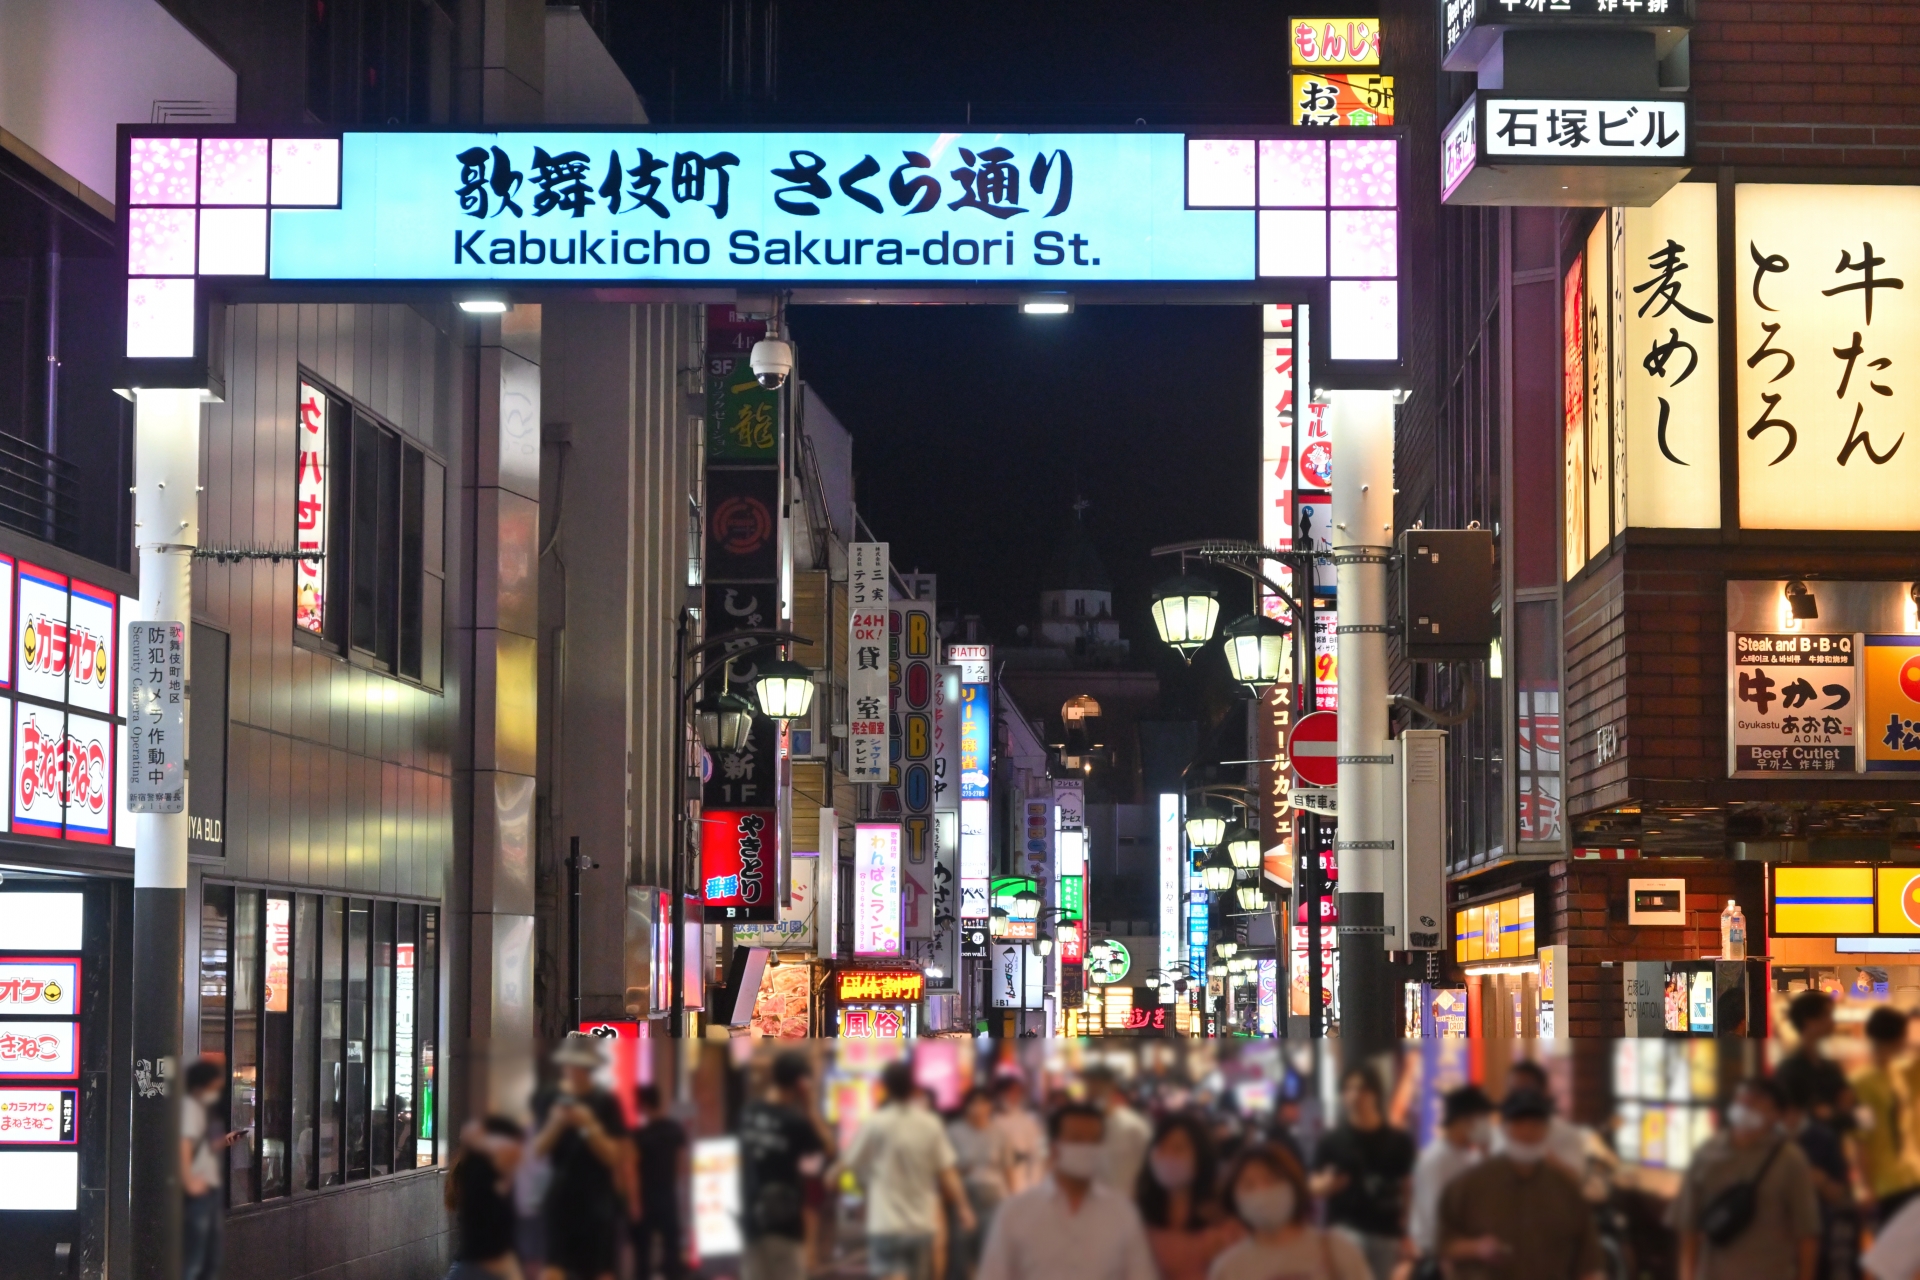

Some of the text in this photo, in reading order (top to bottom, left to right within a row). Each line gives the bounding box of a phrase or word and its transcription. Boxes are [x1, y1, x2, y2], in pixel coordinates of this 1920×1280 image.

[1496, 107, 1680, 148] 石塚ビル
[455, 146, 1073, 219] 歌舞伎町 さくら通り
[454, 230, 1100, 265] Kabukicho Sakura-dori St.
[1633, 239, 1714, 467] 麦めし
[1747, 239, 1798, 467] とろろ
[1822, 242, 1905, 467] 牛たん
[711, 359, 732, 375] 3F
[853, 570, 866, 603] テラコ
[853, 614, 884, 627] 24H
[855, 628, 883, 640] OK!
[1738, 637, 1773, 652] Steak
[1775, 637, 1797, 652] and
[35, 615, 97, 682] カラオケ
[950, 647, 987, 657] PIATTO
[169, 626, 181, 705] 歌舞伎町地区
[1738, 668, 1851, 715] 牛かつ
[130, 626, 143, 784] Security Camera Operating
[147, 626, 166, 786] 防犯カメラ作動中
[851, 721, 885, 735] 完全個室
[906, 611, 931, 863] ROBOT
[1738, 721, 1780, 729] Gyukastu
[1781, 715, 1842, 735] あおな
[1793, 735, 1832, 743] AONA
[20, 714, 105, 812] まねきねこ
[1271, 688, 1291, 833] スコールカフェ
[1751, 747, 1840, 759] Beef Cutlet
[1799, 760, 1836, 770] 炸牛排
[129, 792, 182, 803] 新宿警察署長
[723, 784, 757, 803] 1F
[1294, 794, 1337, 810] 自転車を
[204, 818, 223, 843] BLD.
[738, 814, 765, 903] やきとり
[870, 835, 885, 946] わんぱくランド
[974, 934, 983, 943] 2F
[845, 1013, 899, 1039] 風俗
[9, 1102, 47, 1111] カラオケ
[1, 1115, 53, 1131] まねきねこ
